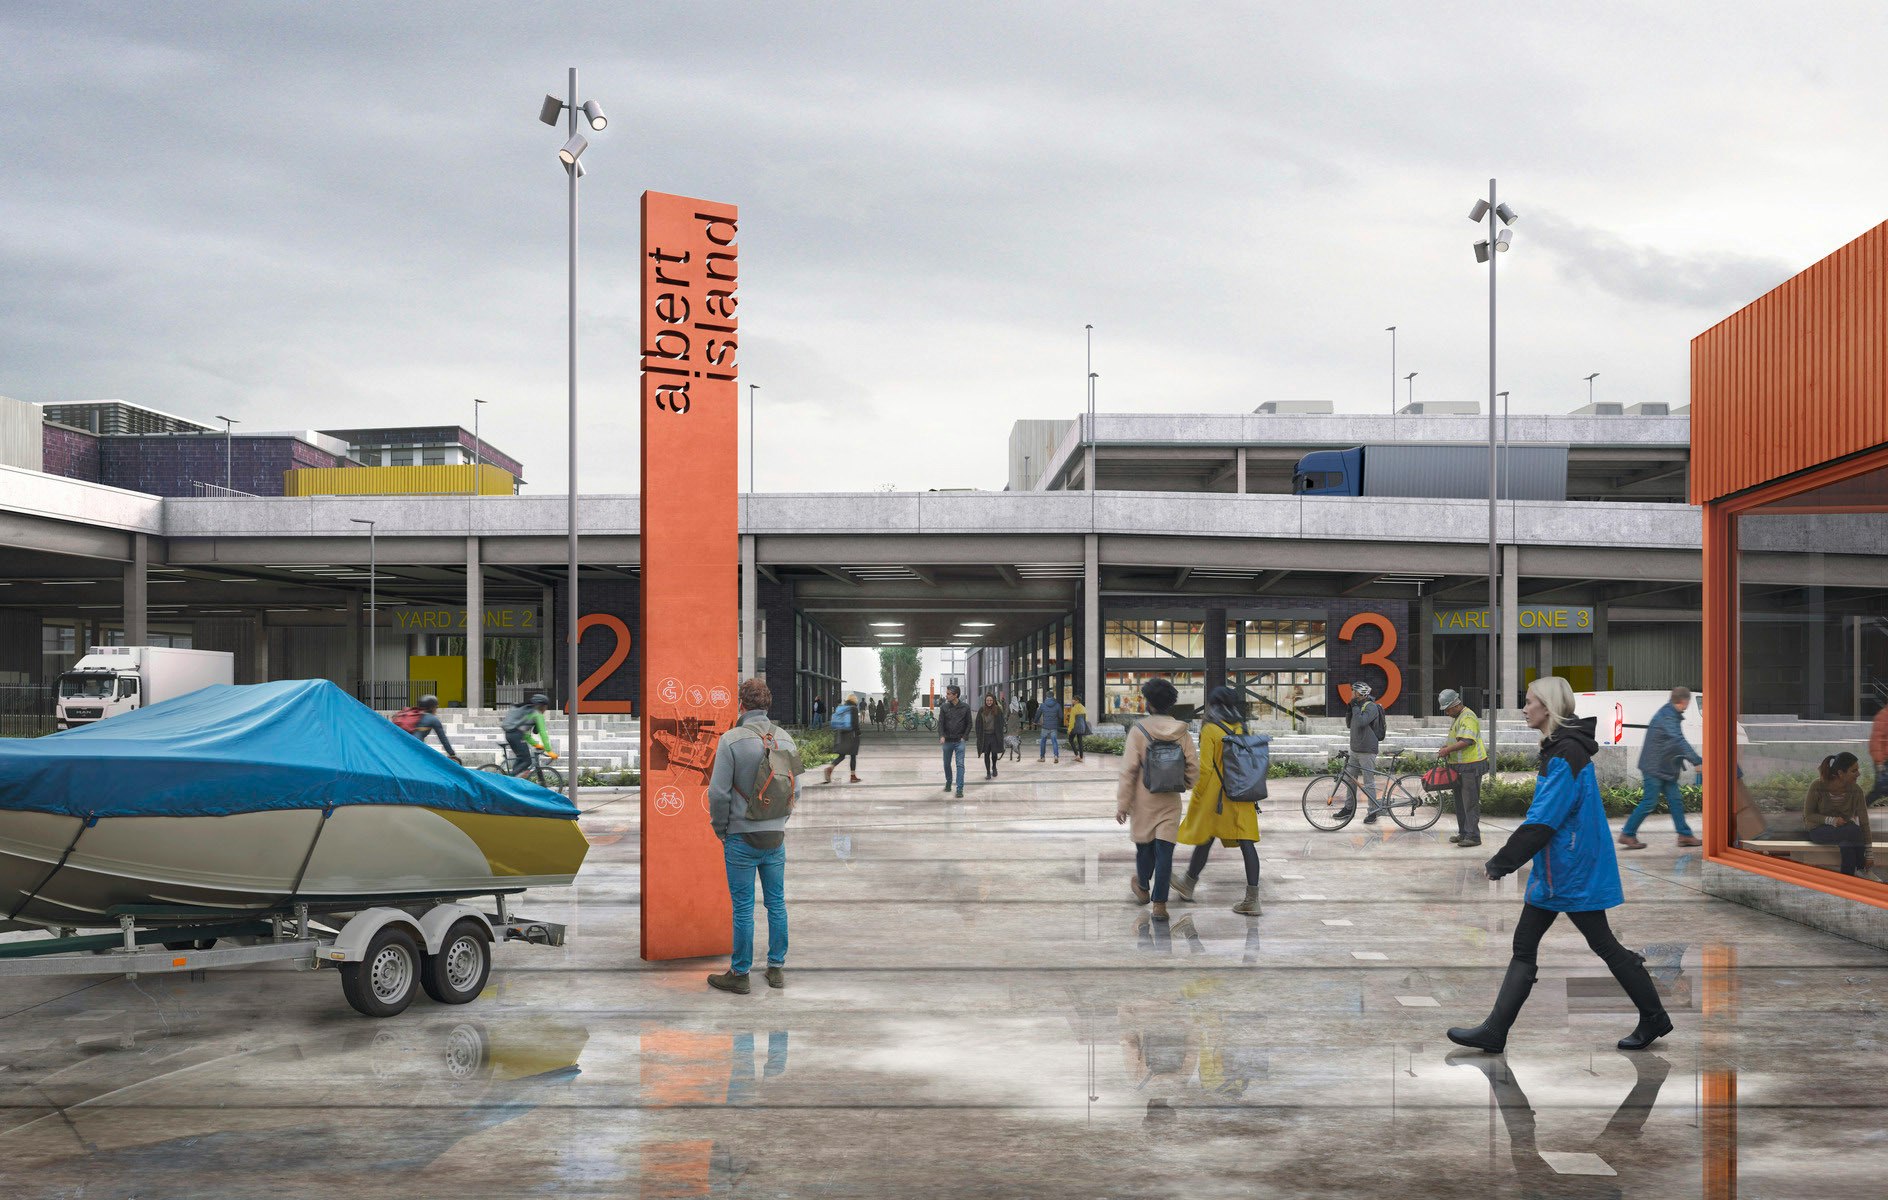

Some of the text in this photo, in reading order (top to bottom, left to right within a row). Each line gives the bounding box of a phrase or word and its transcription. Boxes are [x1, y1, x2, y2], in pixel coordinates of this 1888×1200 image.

[641, 247, 690, 414] albert
[694, 213, 738, 382] island
[396, 609, 534, 628] YARD ZNE 2
[565, 613, 631, 713] 2
[1337, 612, 1402, 711] 3
[1519, 610, 1568, 628] ONE
[1577, 610, 1589, 628] 3
